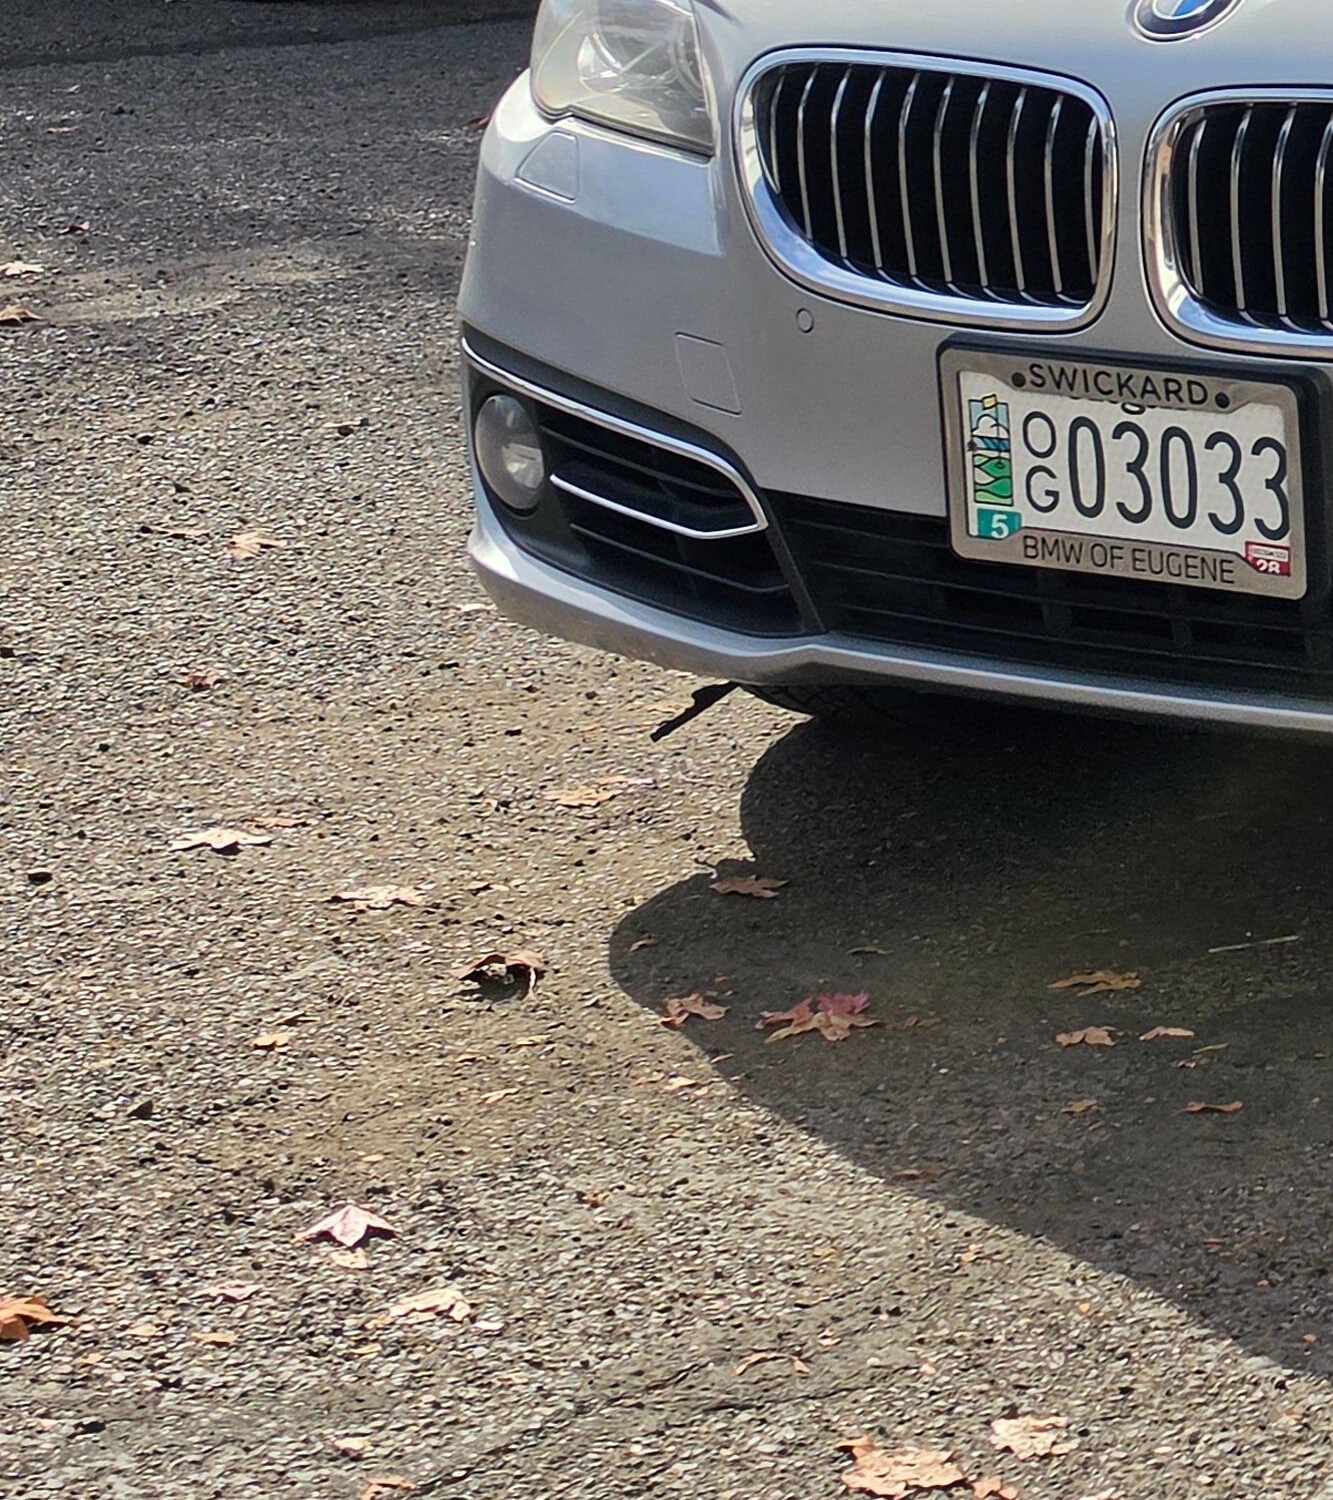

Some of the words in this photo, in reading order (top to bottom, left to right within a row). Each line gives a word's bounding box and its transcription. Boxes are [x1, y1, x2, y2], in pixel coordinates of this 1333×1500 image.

[1029, 363, 1209, 407] SWICKARD
[1067, 415, 1291, 542] 03033
[991, 513, 1010, 539] 5
[1022, 535, 1084, 565] BMW
[1087, 542, 1125, 571] OF
[1132, 549, 1237, 585] EUGENE
